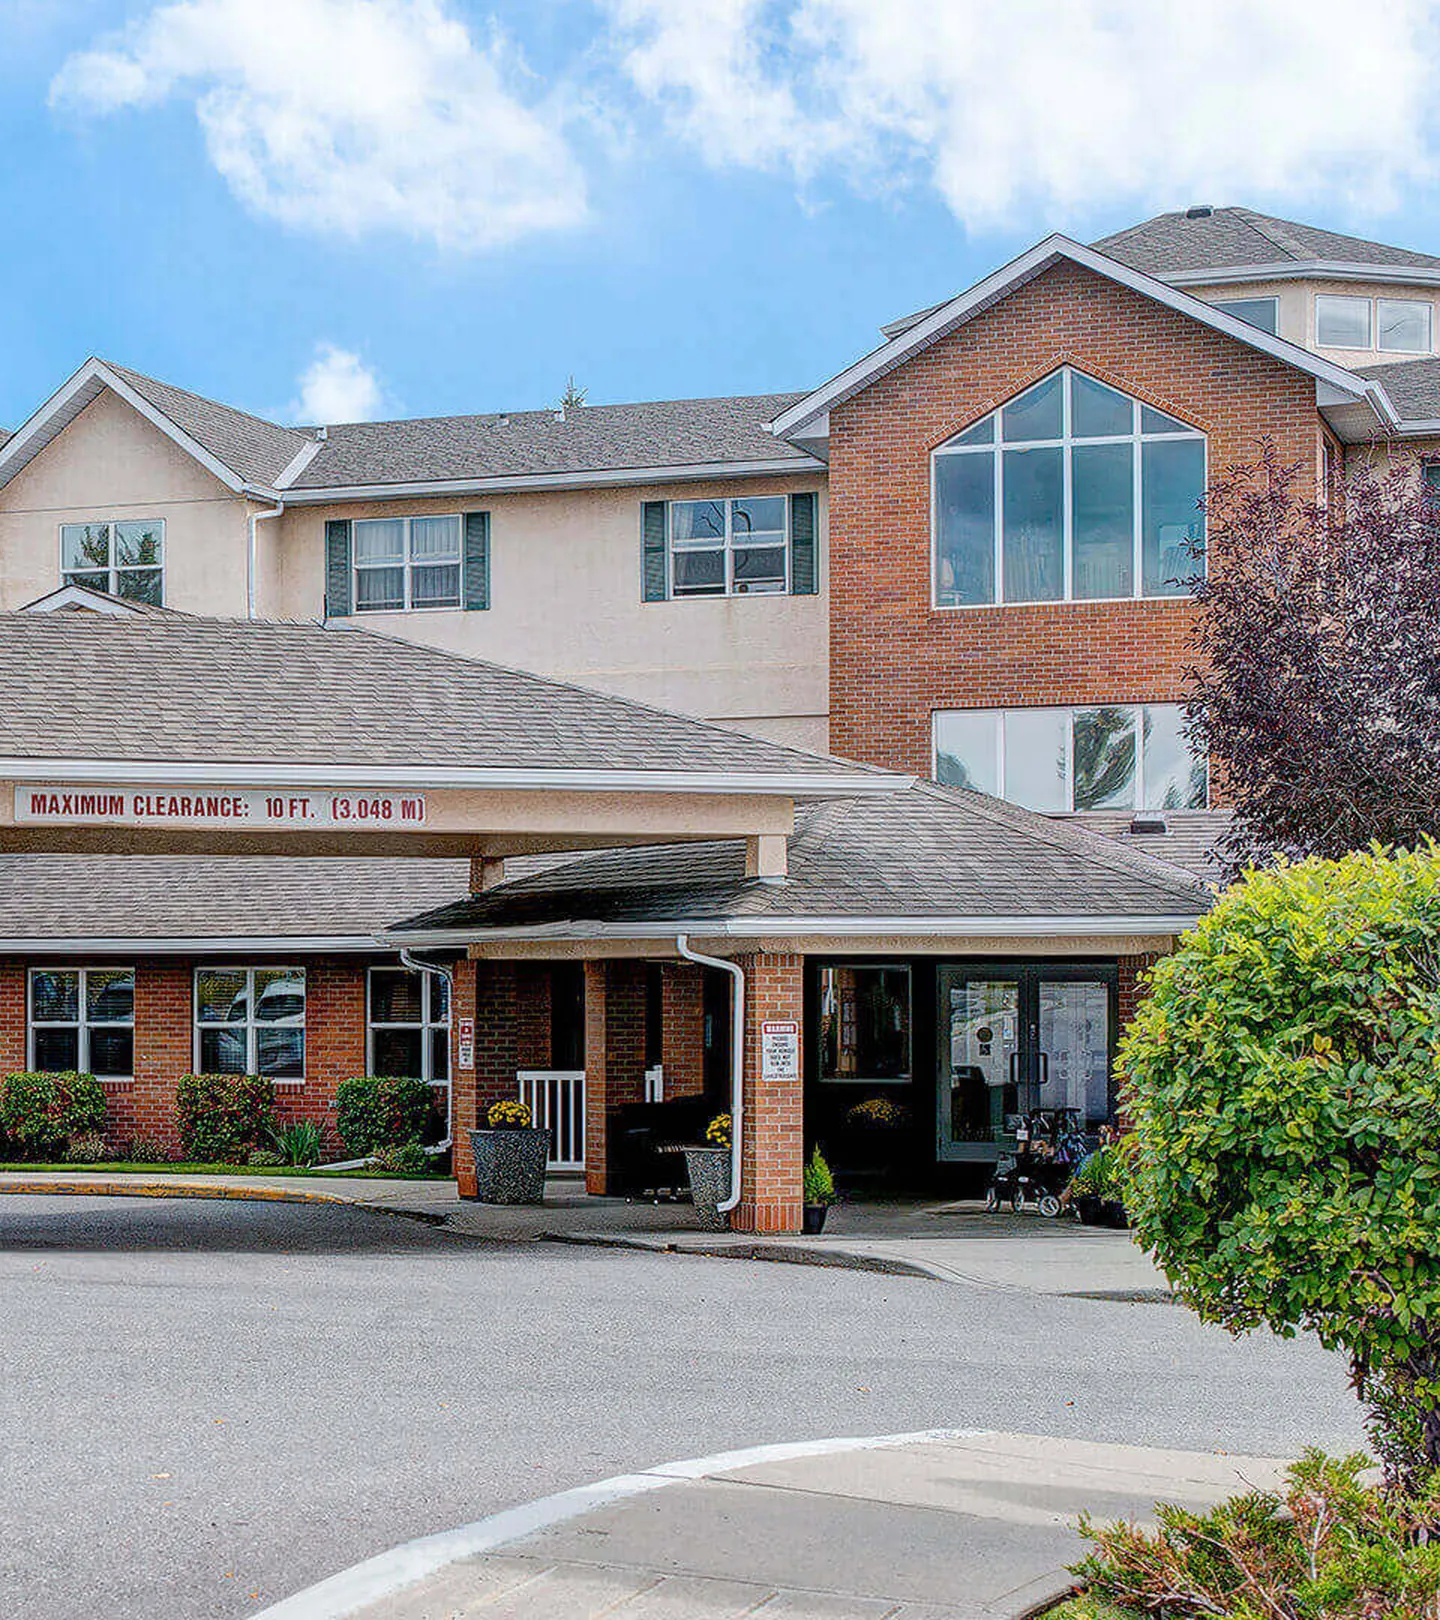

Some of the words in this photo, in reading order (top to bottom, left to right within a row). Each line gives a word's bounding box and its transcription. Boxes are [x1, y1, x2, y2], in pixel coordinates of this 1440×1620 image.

[31, 794, 124, 816] MAXIMUM
[133, 796, 249, 818] CLEARANCE:
[265, 797, 284, 818] 10
[288, 797, 315, 819] FT.
[332, 798, 392, 820] (3.048
[401, 799, 424, 821] M)
